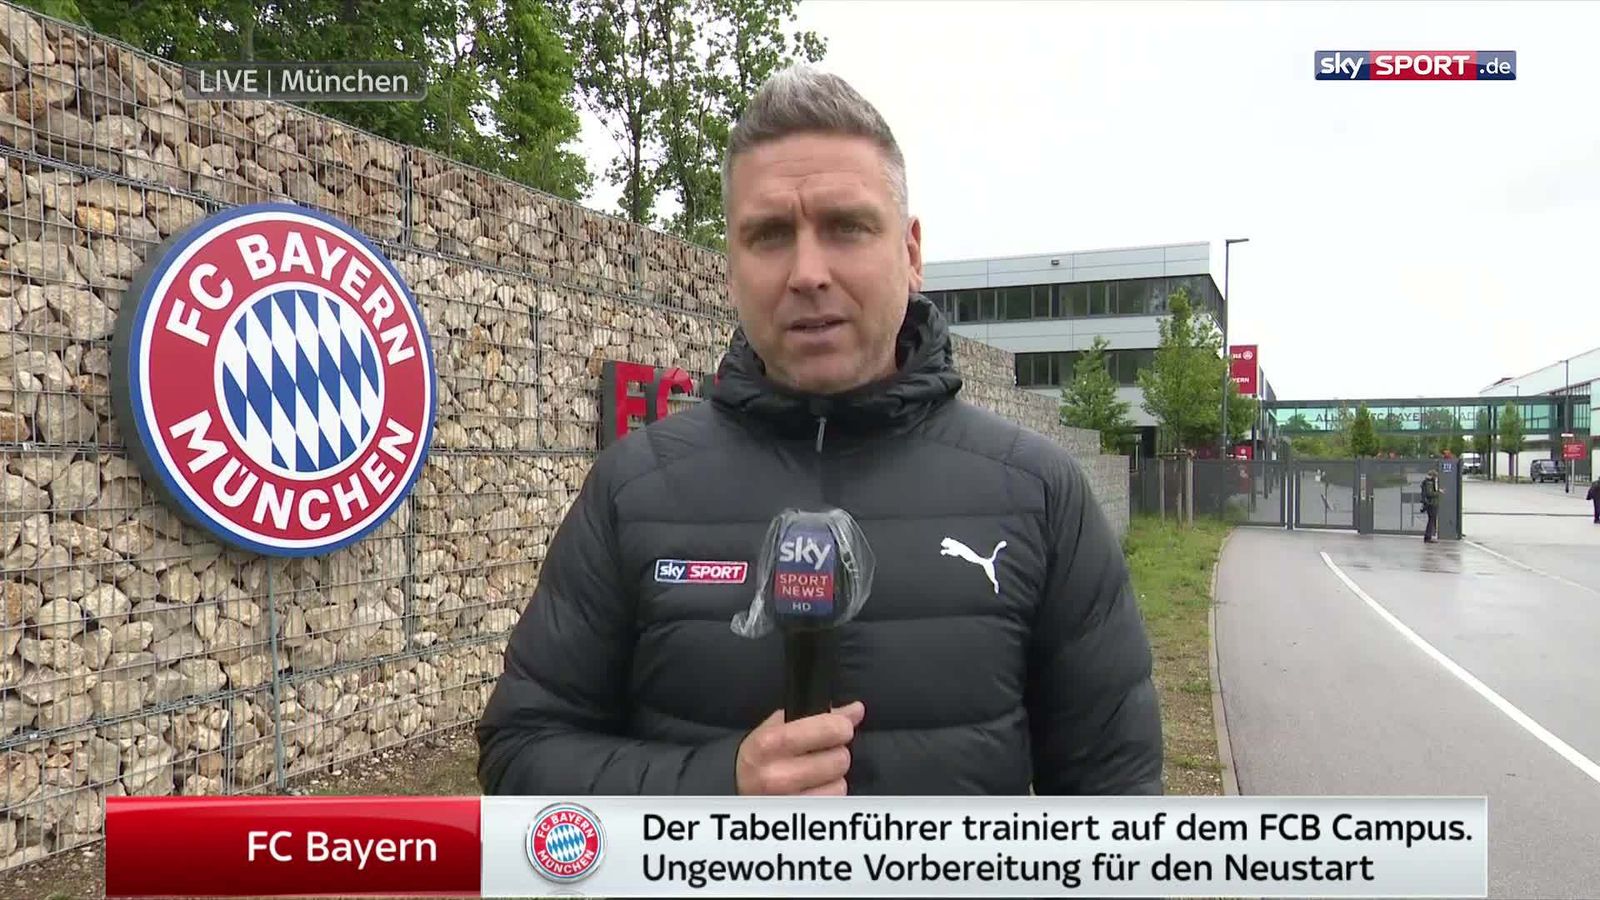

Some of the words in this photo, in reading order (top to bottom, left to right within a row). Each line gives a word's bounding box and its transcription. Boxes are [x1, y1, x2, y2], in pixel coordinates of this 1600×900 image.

[166, 263, 234, 347] FC
[236, 231, 415, 366] BAYERN
[169, 410, 415, 531] MÜNCHEN
[778, 536, 832, 570] sky
[659, 562, 686, 580] sky
[688, 564, 743, 579] SPORT
[779, 573, 829, 586] SPORT
[782, 585, 826, 598] NEWS
[792, 601, 812, 612] HD
